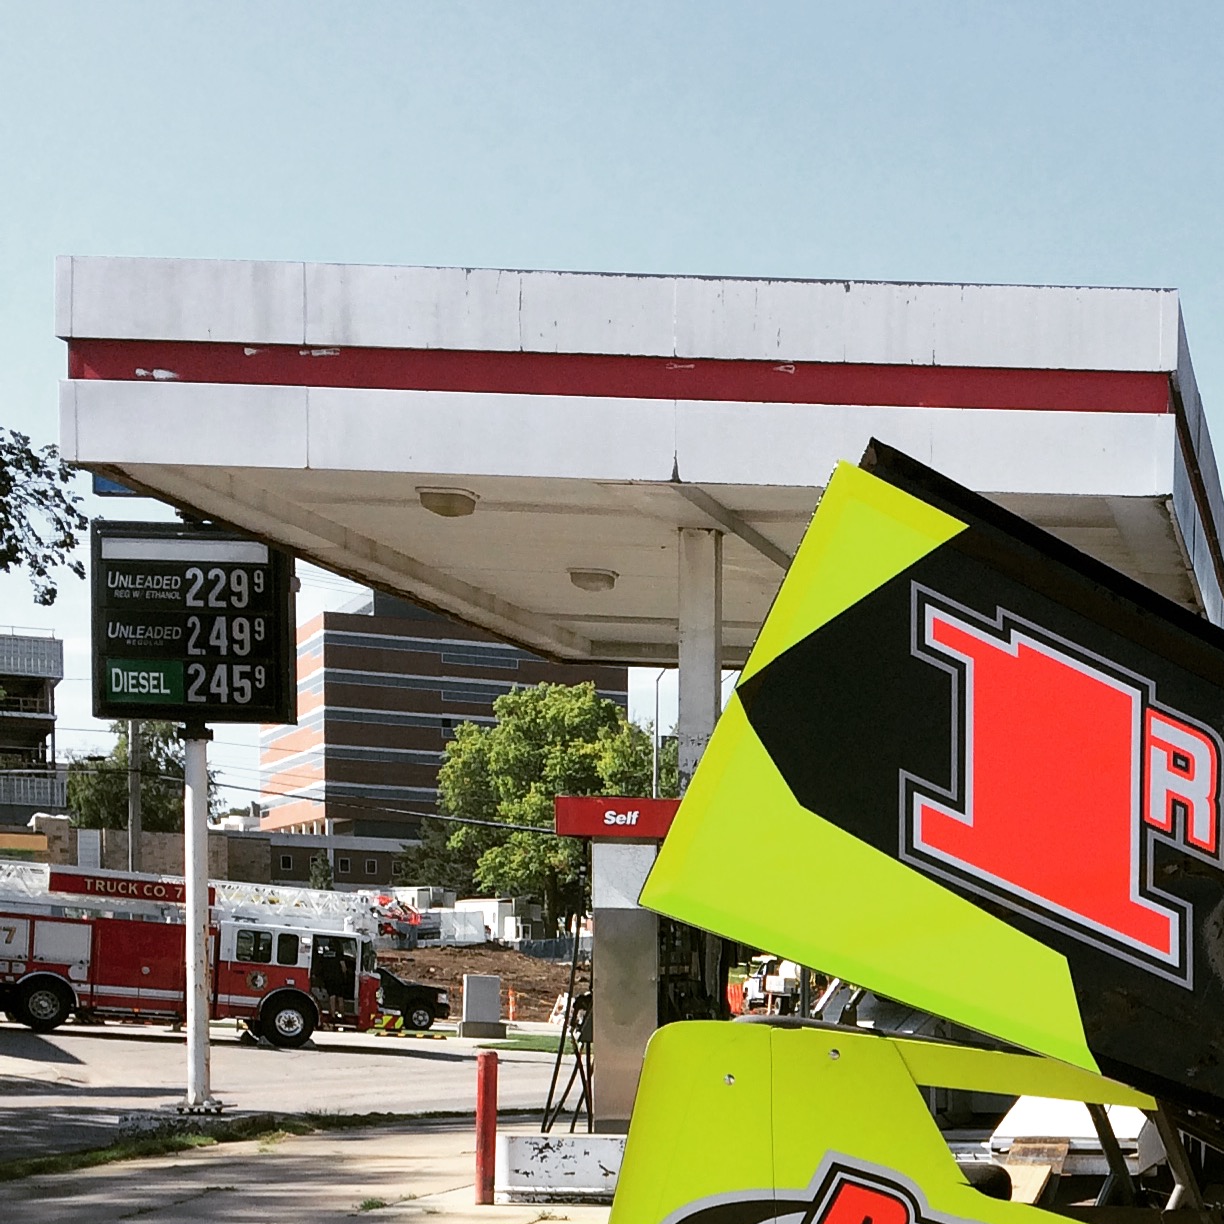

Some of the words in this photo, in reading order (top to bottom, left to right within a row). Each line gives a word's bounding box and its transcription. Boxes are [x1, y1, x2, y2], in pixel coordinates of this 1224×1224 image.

[107, 571, 181, 589] UNLEADED
[107, 621, 182, 640] UNLEADED
[111, 668, 171, 694] DIESEL
[603, 810, 639, 826] Self
[84, 878, 138, 895] TRUCK
[143, 883, 169, 898] CO.
[174, 887, 183, 898] 7
